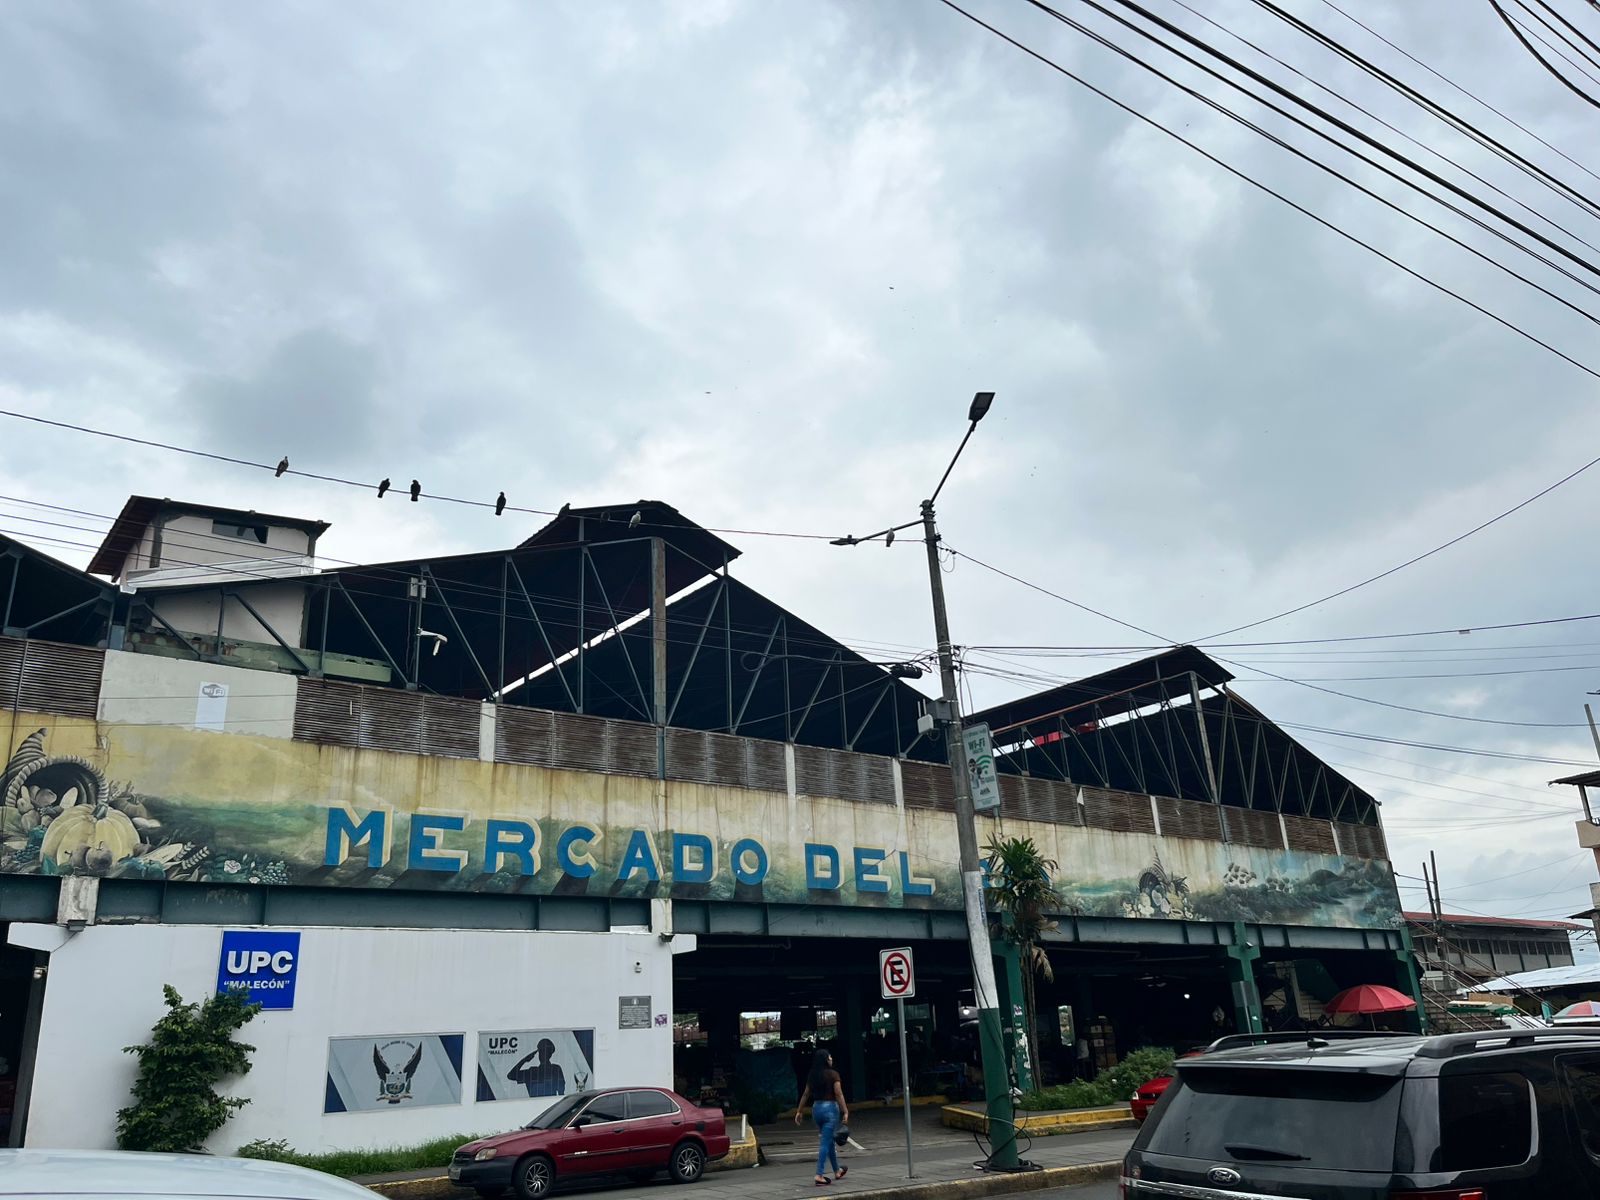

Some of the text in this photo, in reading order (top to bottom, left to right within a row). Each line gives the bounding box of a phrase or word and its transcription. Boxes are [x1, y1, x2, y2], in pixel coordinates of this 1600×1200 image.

[324, 804, 771, 886] MERCADO
[804, 842, 935, 896] DEL
[227, 950, 294, 974] UPC
[488, 1037, 518, 1049] UPC
